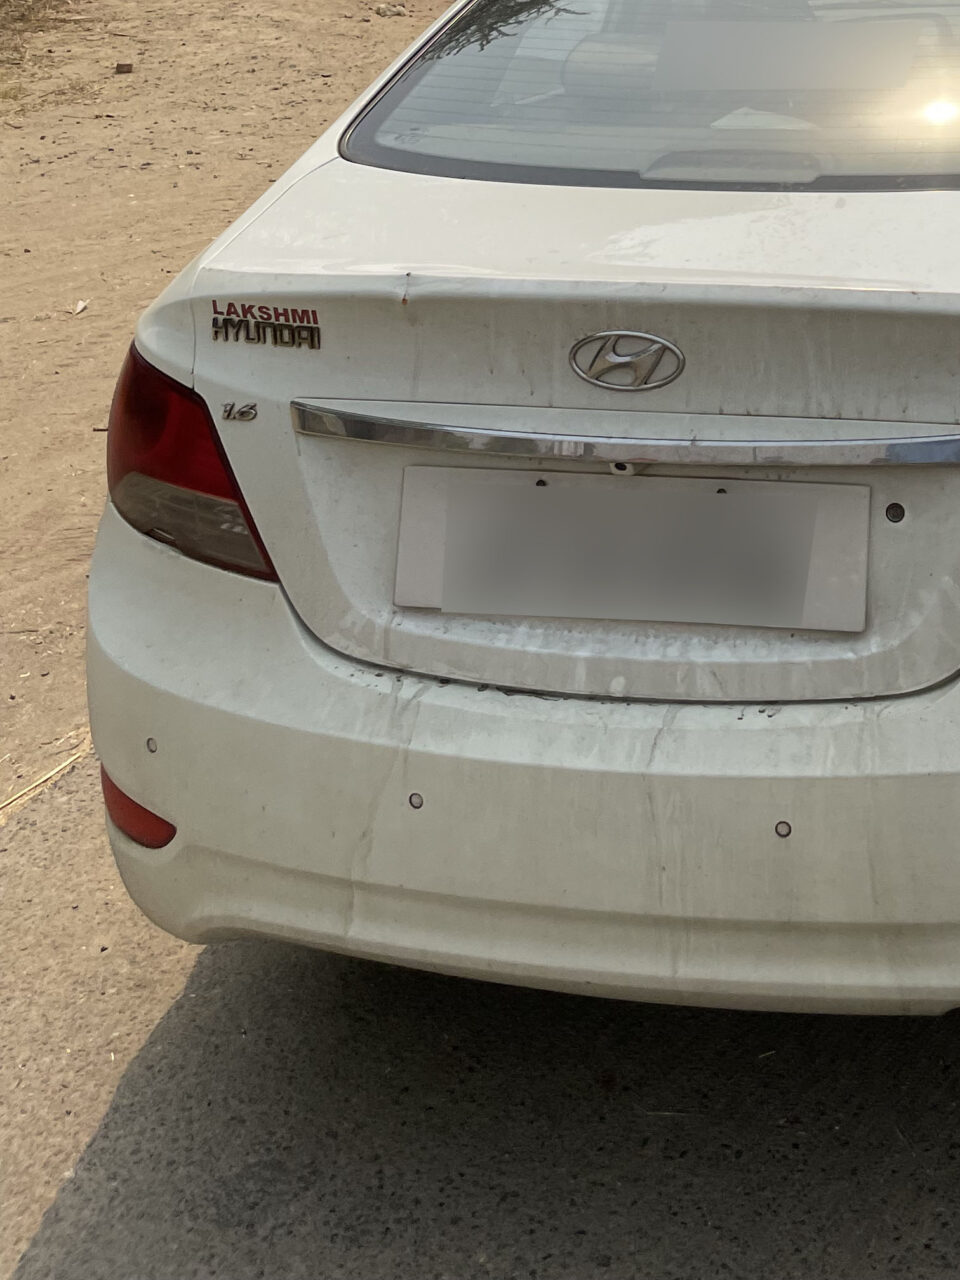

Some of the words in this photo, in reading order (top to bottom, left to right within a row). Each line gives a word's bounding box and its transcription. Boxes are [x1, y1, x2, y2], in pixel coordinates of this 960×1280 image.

[212, 300, 319, 325] LAKSHMI
[212, 317, 321, 350] HYUNDAI
[222, 402, 258, 421] 1.6
